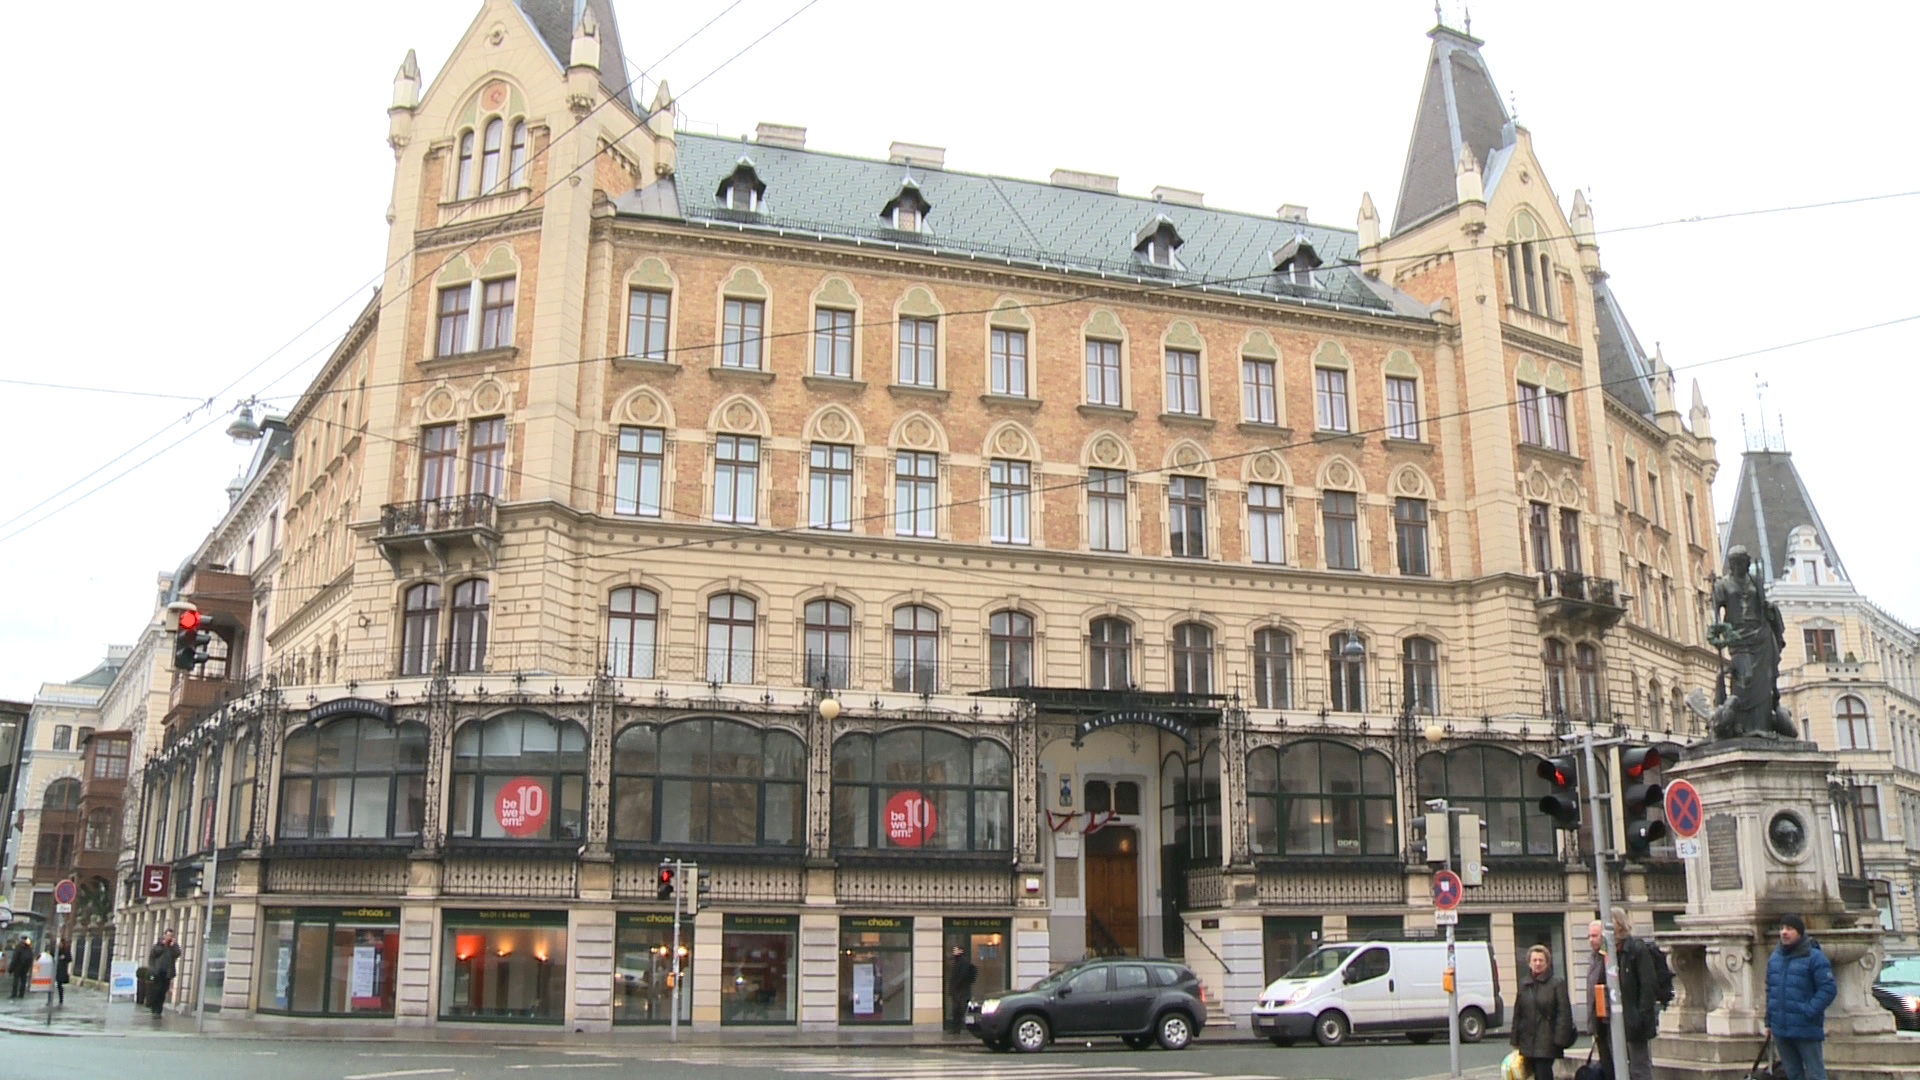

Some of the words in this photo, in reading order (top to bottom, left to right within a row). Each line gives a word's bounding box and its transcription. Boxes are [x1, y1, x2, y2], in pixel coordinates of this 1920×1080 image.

[502, 797, 517, 809] be
[517, 785, 543, 817] 10
[502, 809, 518, 818] we
[890, 810, 905, 821] be
[904, 798, 930, 828] 10
[890, 821, 907, 829] we
[149, 876, 163, 892] 5
[629, 913, 674, 923] www.chaos
